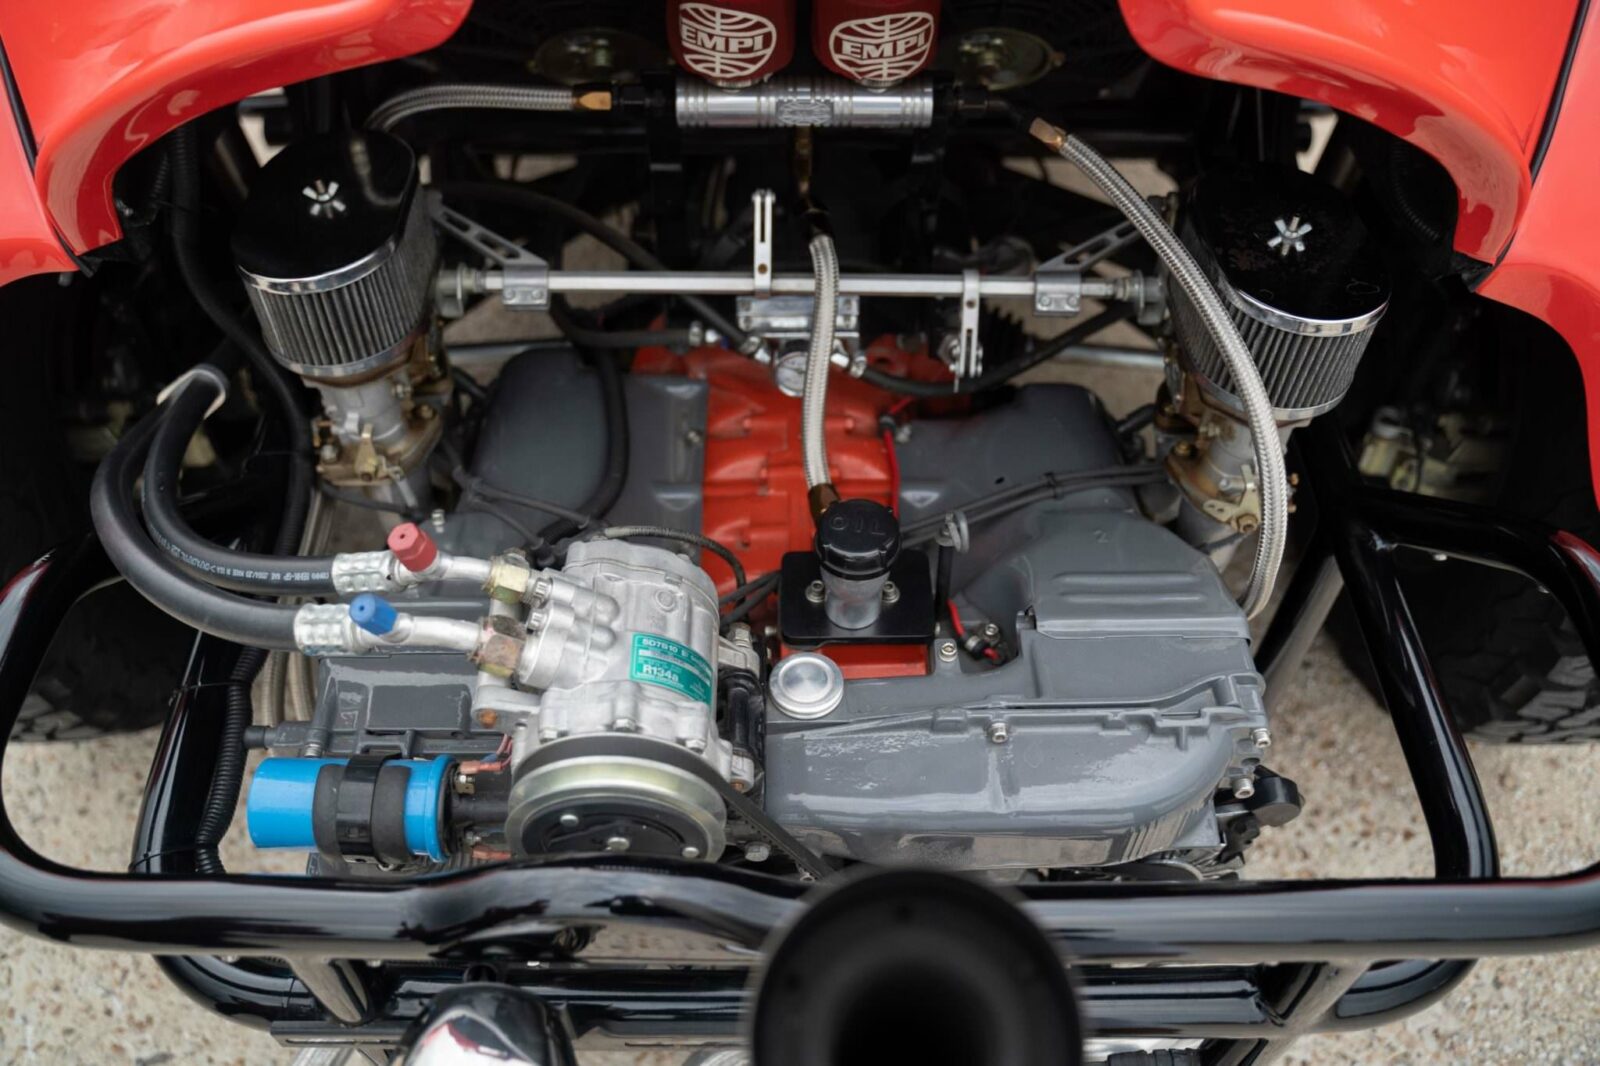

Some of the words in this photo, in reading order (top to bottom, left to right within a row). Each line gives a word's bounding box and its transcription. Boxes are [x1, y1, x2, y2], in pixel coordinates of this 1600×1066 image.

[681, 24, 764, 53] EMPI
[841, 31, 925, 59] EMPI
[830, 510, 886, 536] OIL
[643, 664, 679, 683] R134a
